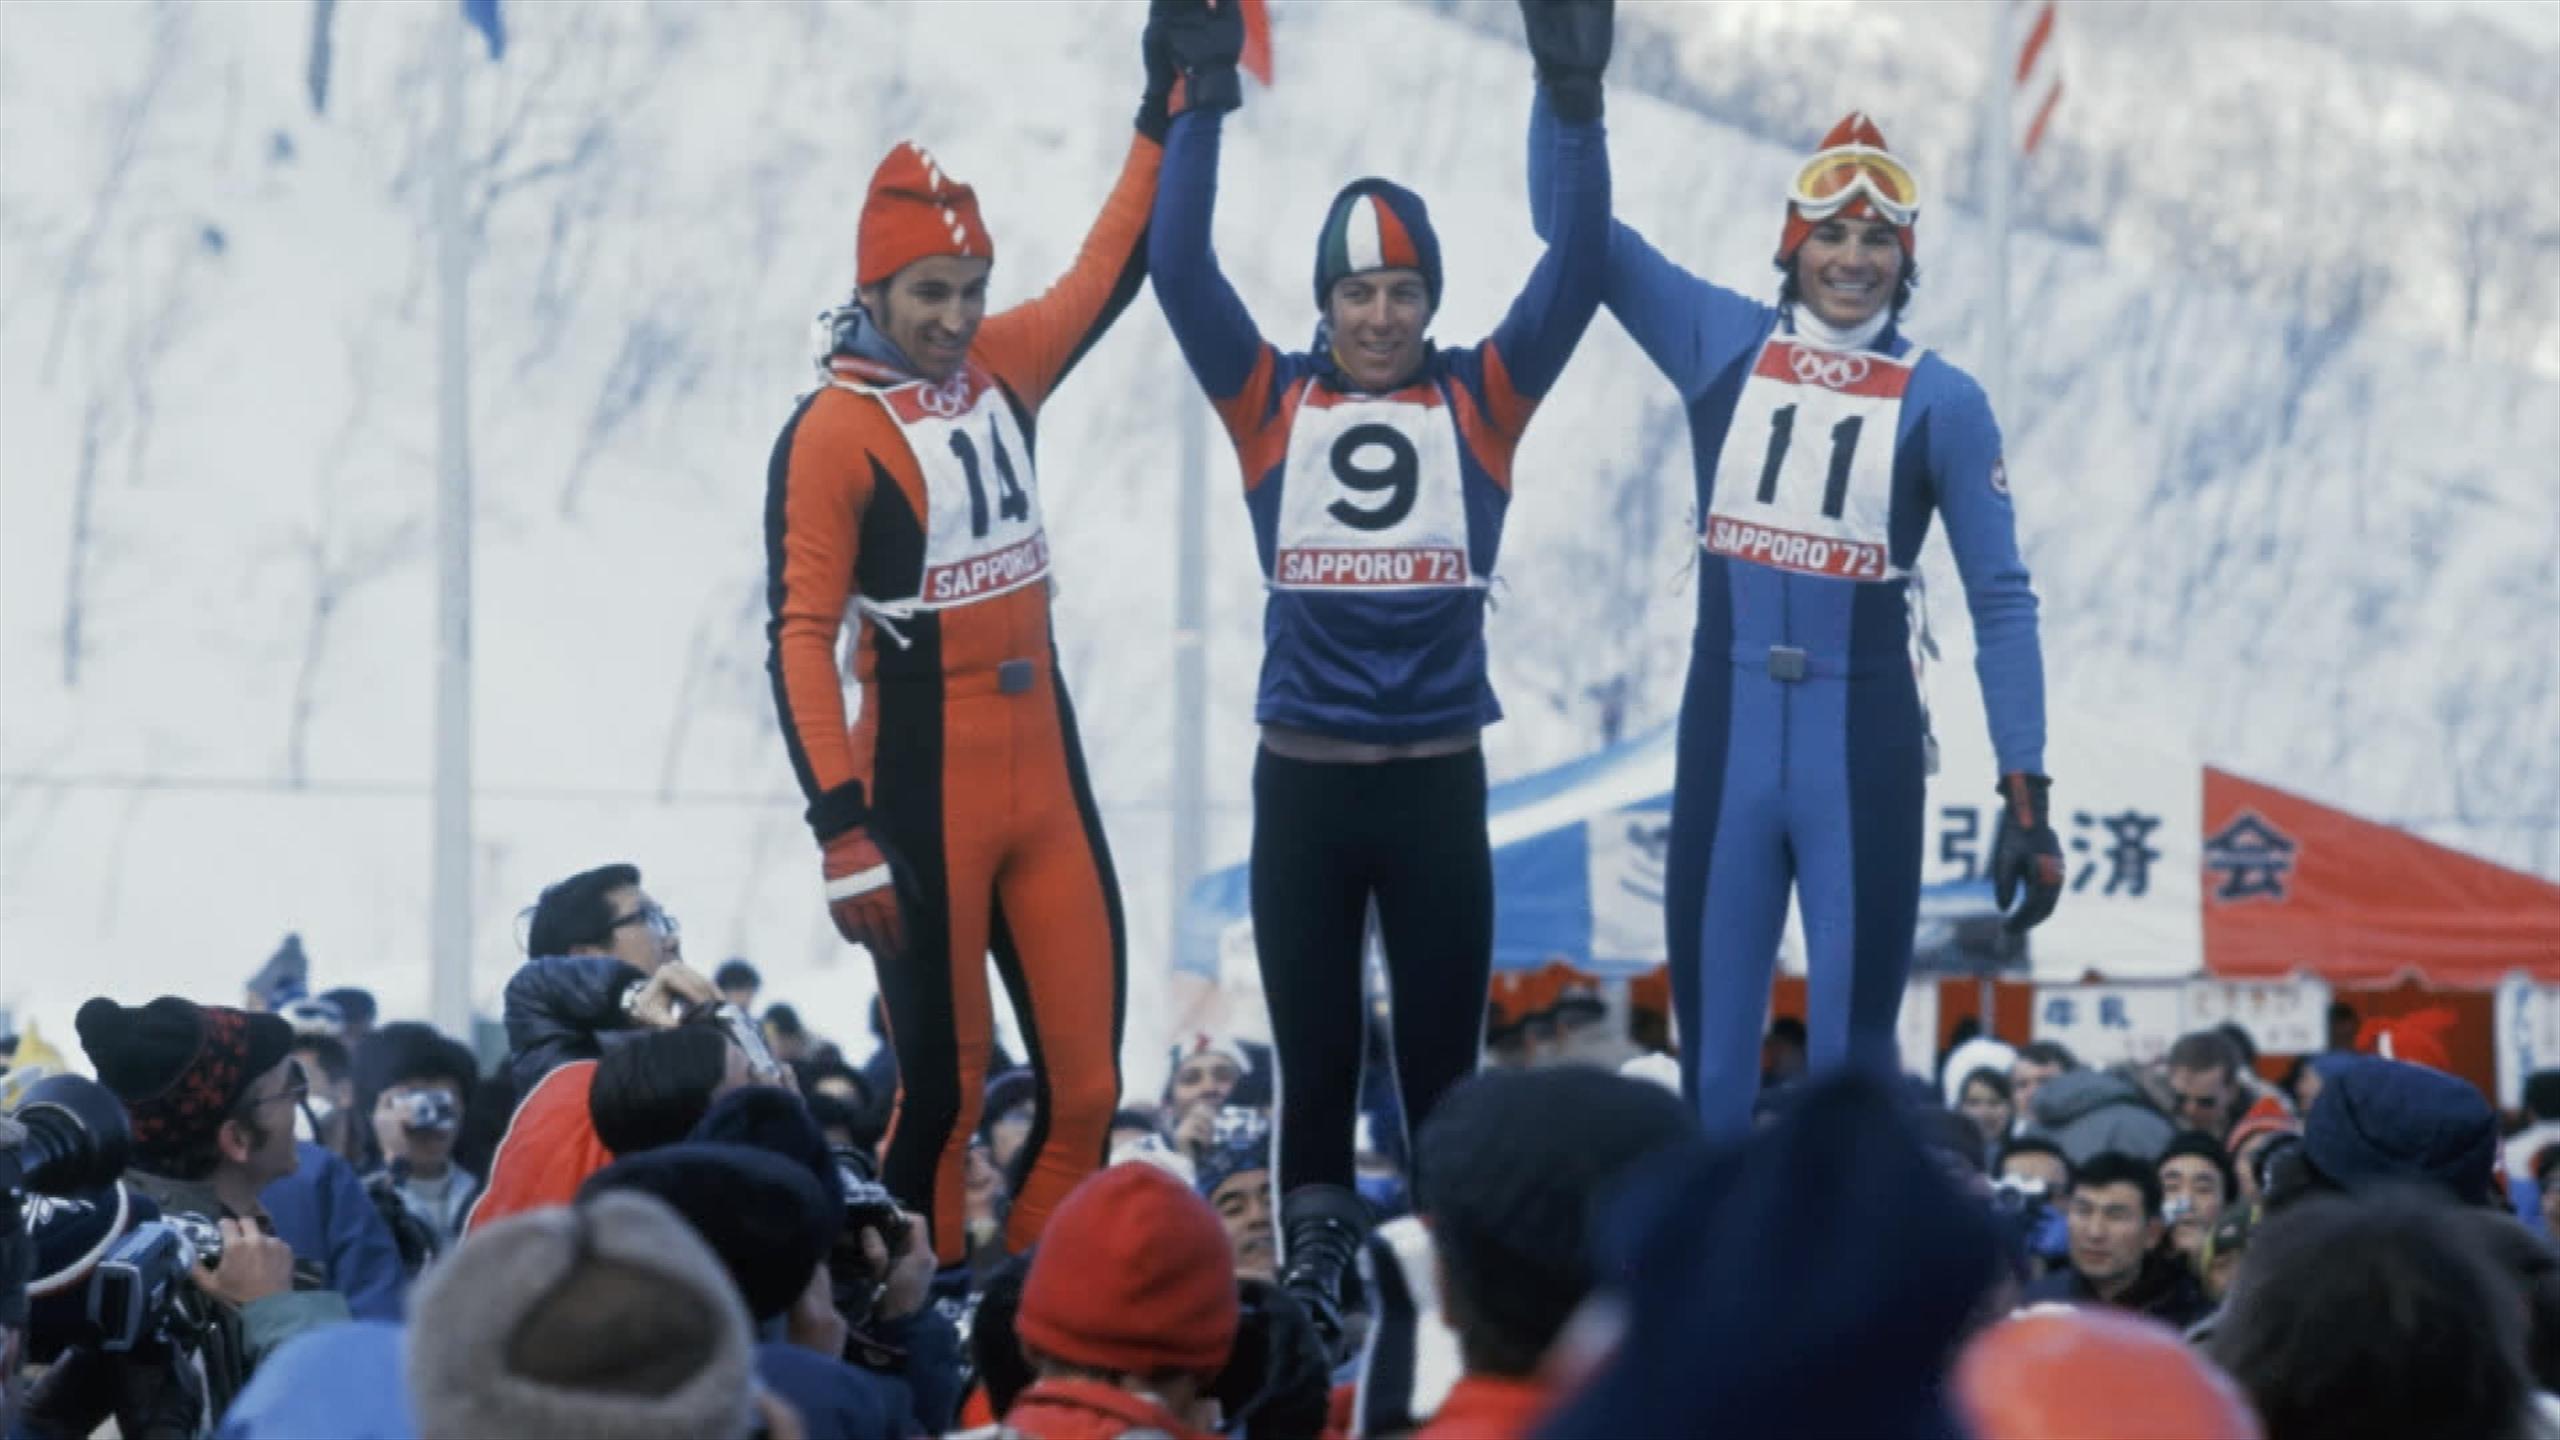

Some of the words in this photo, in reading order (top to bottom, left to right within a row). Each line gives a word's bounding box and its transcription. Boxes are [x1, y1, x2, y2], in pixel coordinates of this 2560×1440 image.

[948, 412, 1028, 538] 14
[1328, 423, 1419, 531] 9
[1757, 403, 1864, 519] 11
